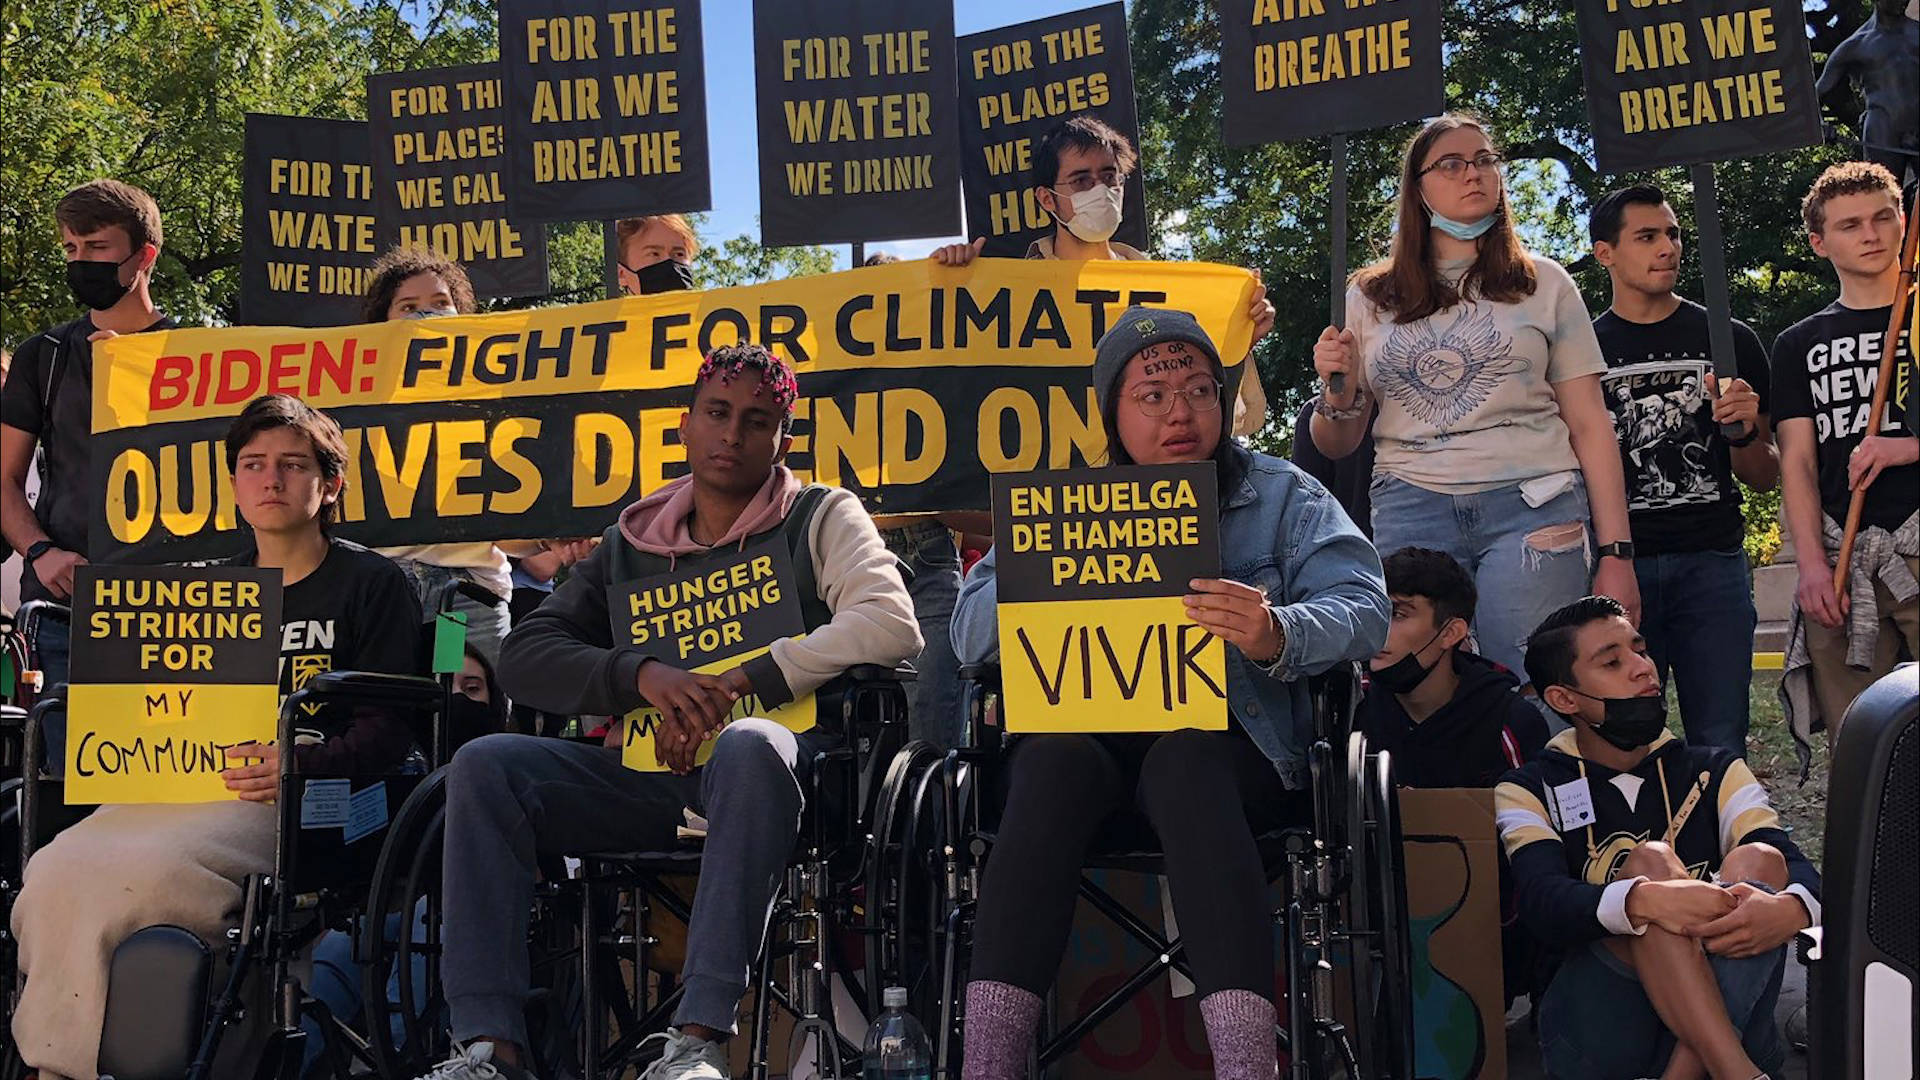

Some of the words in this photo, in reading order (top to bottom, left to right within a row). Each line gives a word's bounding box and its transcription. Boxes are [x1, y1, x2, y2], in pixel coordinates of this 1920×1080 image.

[527, 15, 598, 64] FOR
[608, 8, 677, 57] THE
[783, 36, 851, 81] FOR
[863, 30, 930, 76] THE
[973, 39, 1034, 80] FOR
[1041, 23, 1104, 64] THE
[1255, 18, 1411, 92] BREATHE
[1615, 21, 1690, 73] AIR
[1701, 7, 1776, 60] WE
[390, 85, 449, 118] FOR
[456, 79, 502, 112] TH
[531, 77, 601, 123] AIR
[613, 71, 679, 117] WE
[783, 92, 932, 144] WATER
[978, 72, 1110, 130] PLACES
[1619, 69, 1785, 134] BREATHE
[393, 124, 503, 165] PLACE
[533, 130, 681, 183] BREATHE
[985, 138, 1032, 177] WE
[270, 158, 332, 198] FOR
[396, 177, 444, 210] WE
[452, 171, 506, 206] CAL
[785, 162, 833, 196] WE
[844, 154, 933, 194] DRINK
[268, 209, 376, 253] WATE
[400, 216, 524, 262] HOME
[267, 261, 310, 293] WE
[149, 338, 377, 411] BIDEN:
[402, 320, 627, 388] FIGHT
[650, 304, 810, 371] FOR
[1140, 347, 1159, 361] US
[1167, 343, 1188, 355] OR
[1144, 355, 1194, 376] EXXON?
[1806, 329, 1909, 373] GREE
[1810, 366, 1878, 409] NEW
[1816, 401, 1902, 444] DEAL
[331, 415, 543, 524] IVES
[572, 387, 947, 512] DEEND
[1010, 486, 1054, 517] EN
[1062, 479, 1198, 515] HUELGA
[1012, 522, 1053, 553] DE
[1062, 515, 1200, 550] HAMBRE
[629, 554, 775, 617] HUNGER
[1051, 552, 1161, 586] PARA
[95, 579, 261, 607] HUNGER
[630, 579, 782, 645] STRIKING
[89, 612, 262, 639] STRIKING
[678, 620, 744, 660] FOR
[140, 643, 214, 671] FOR
[1016, 622, 1227, 712] VIVIR
[144, 689, 194, 718] MY
